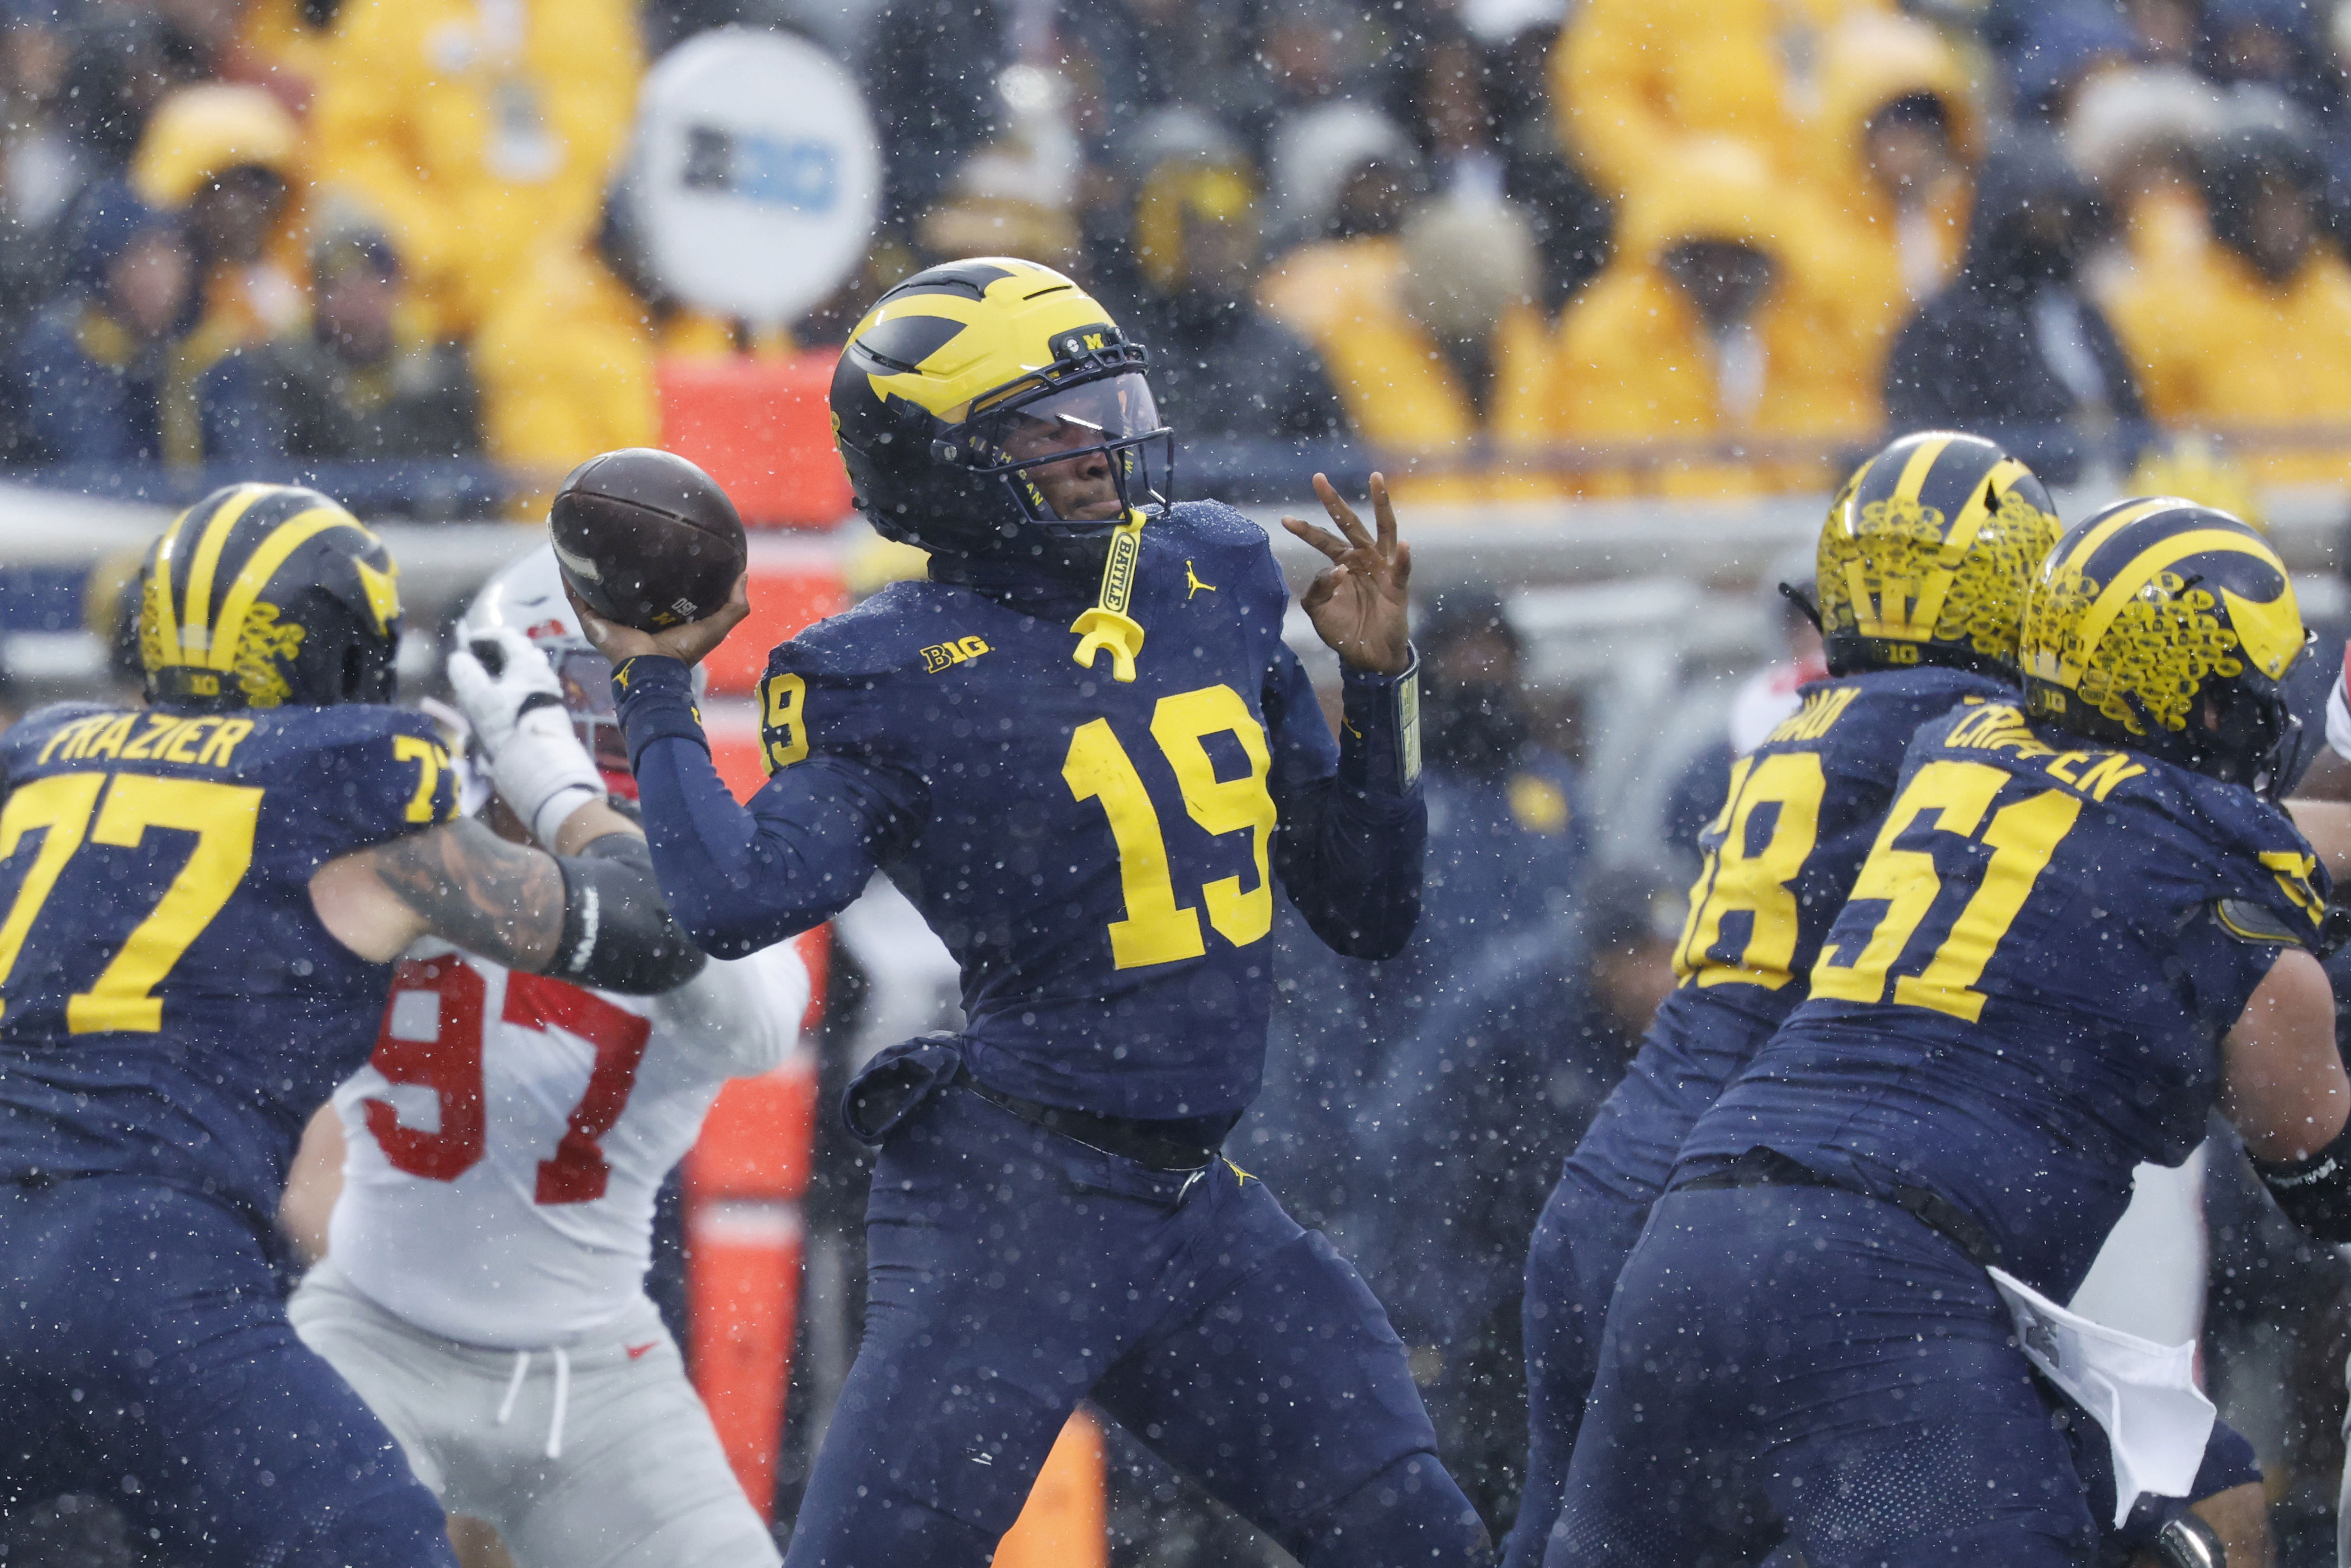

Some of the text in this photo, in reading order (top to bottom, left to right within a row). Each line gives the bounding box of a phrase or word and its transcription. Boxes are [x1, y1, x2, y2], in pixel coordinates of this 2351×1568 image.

[1083, 333, 1105, 350] M
[1107, 540, 1132, 607] BATTLE
[37, 712, 255, 768] FRAZIER
[1062, 684, 1277, 970] 19
[0, 772, 266, 1036] 77
[1807, 760, 2083, 1024] 51
[362, 953, 651, 1205] 97
